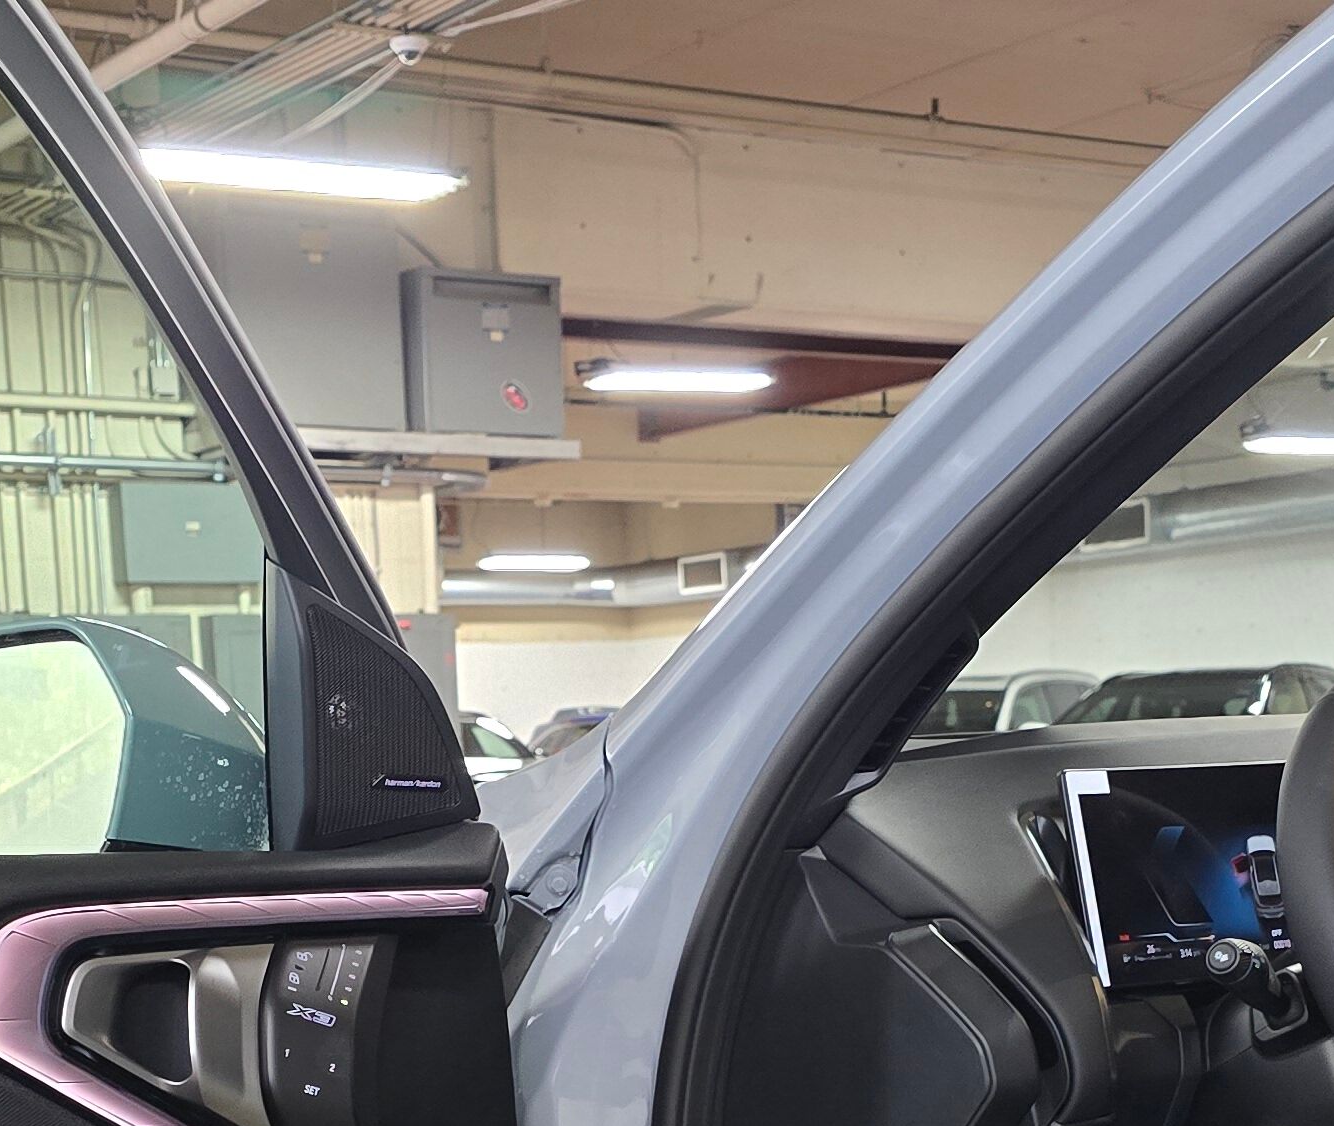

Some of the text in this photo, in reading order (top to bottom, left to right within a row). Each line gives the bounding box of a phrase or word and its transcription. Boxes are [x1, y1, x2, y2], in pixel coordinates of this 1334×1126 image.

[286, 1002, 337, 1028] X3
[329, 1063, 336, 1073] 2
[304, 1084, 320, 1096] SET
